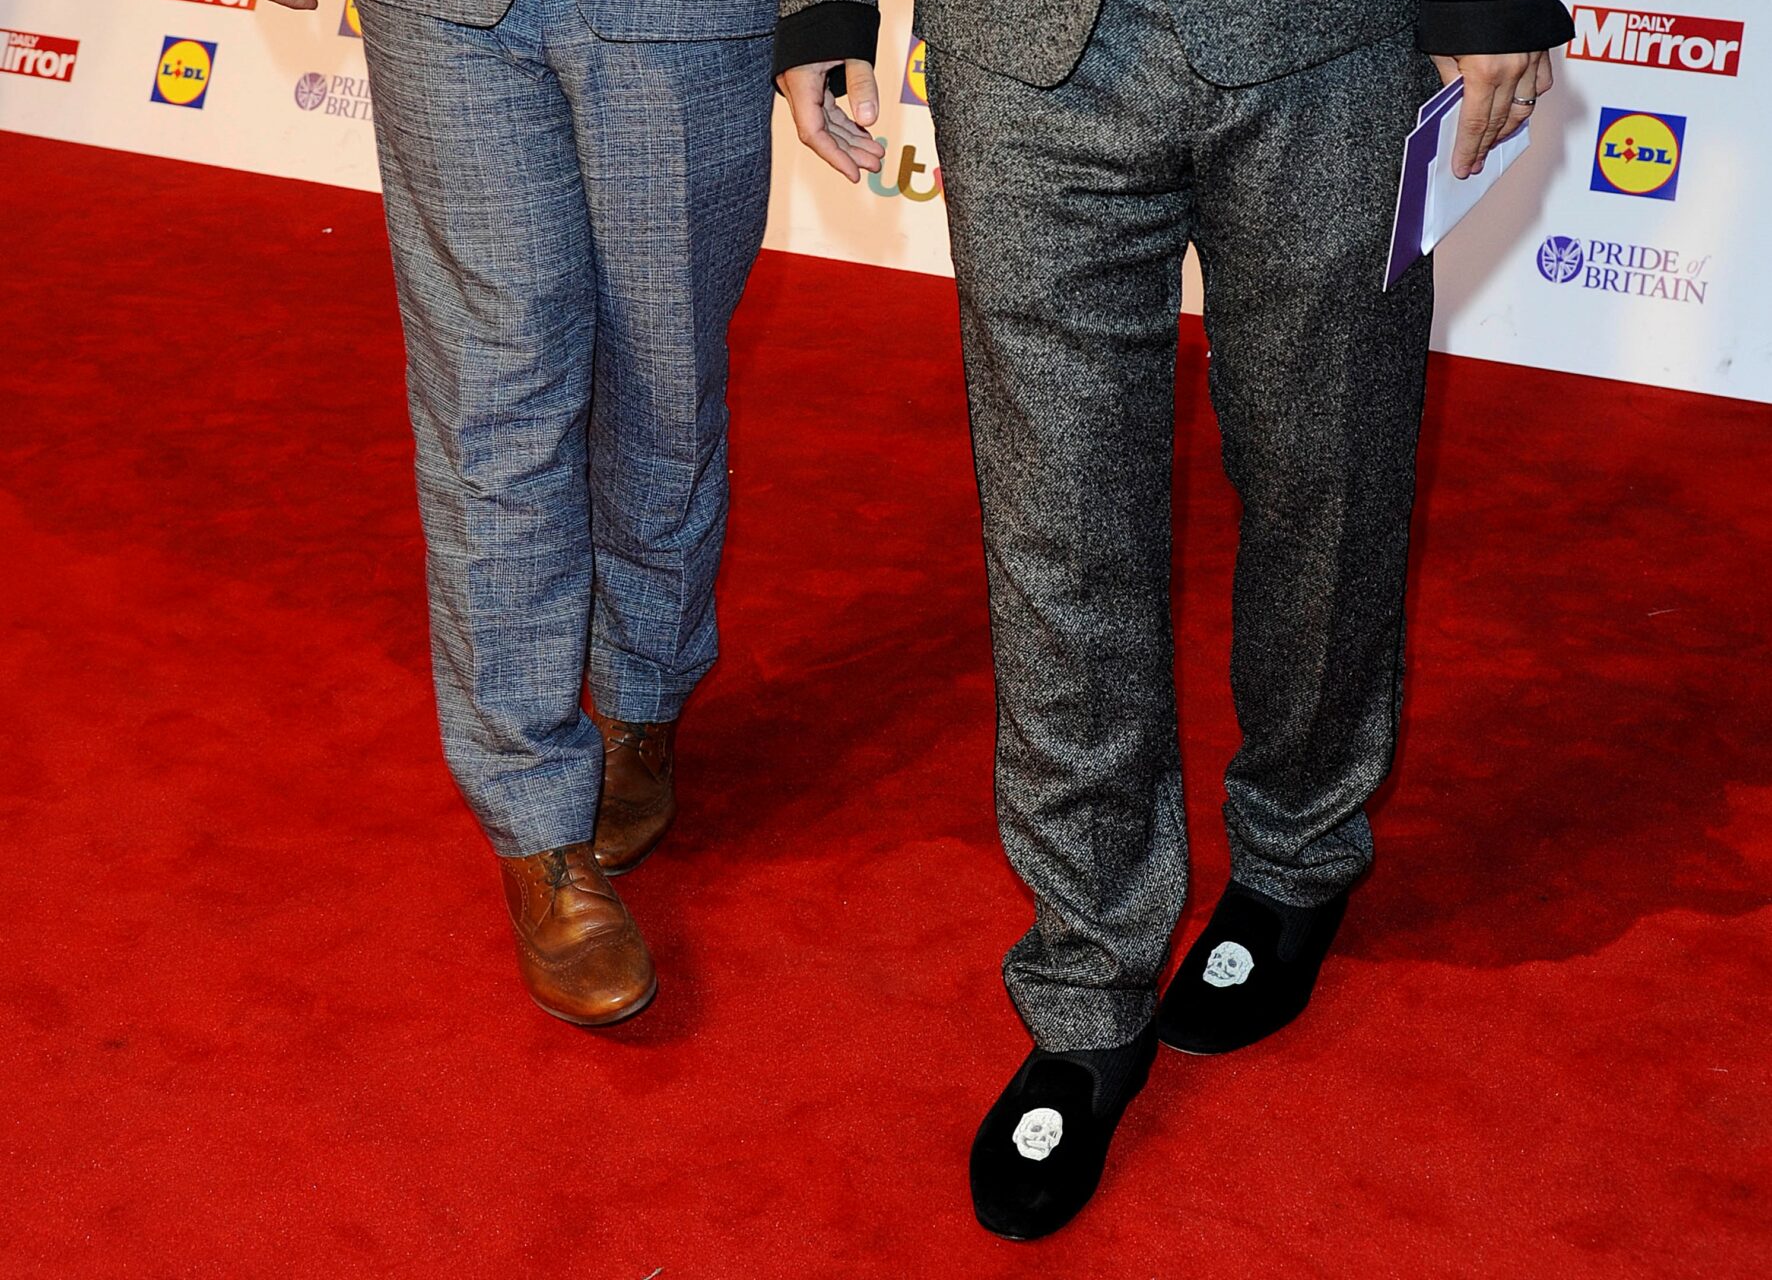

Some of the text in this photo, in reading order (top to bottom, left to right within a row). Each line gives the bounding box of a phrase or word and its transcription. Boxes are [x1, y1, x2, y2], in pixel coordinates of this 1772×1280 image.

[8, 31, 39, 48] DAILY
[1570, 8, 1740, 72] Mirror
[1627, 13, 1675, 32] DAILY
[0, 31, 75, 79] irror
[1586, 240, 1712, 277] PRIDE of
[1582, 265, 1708, 304] BRITAIN
